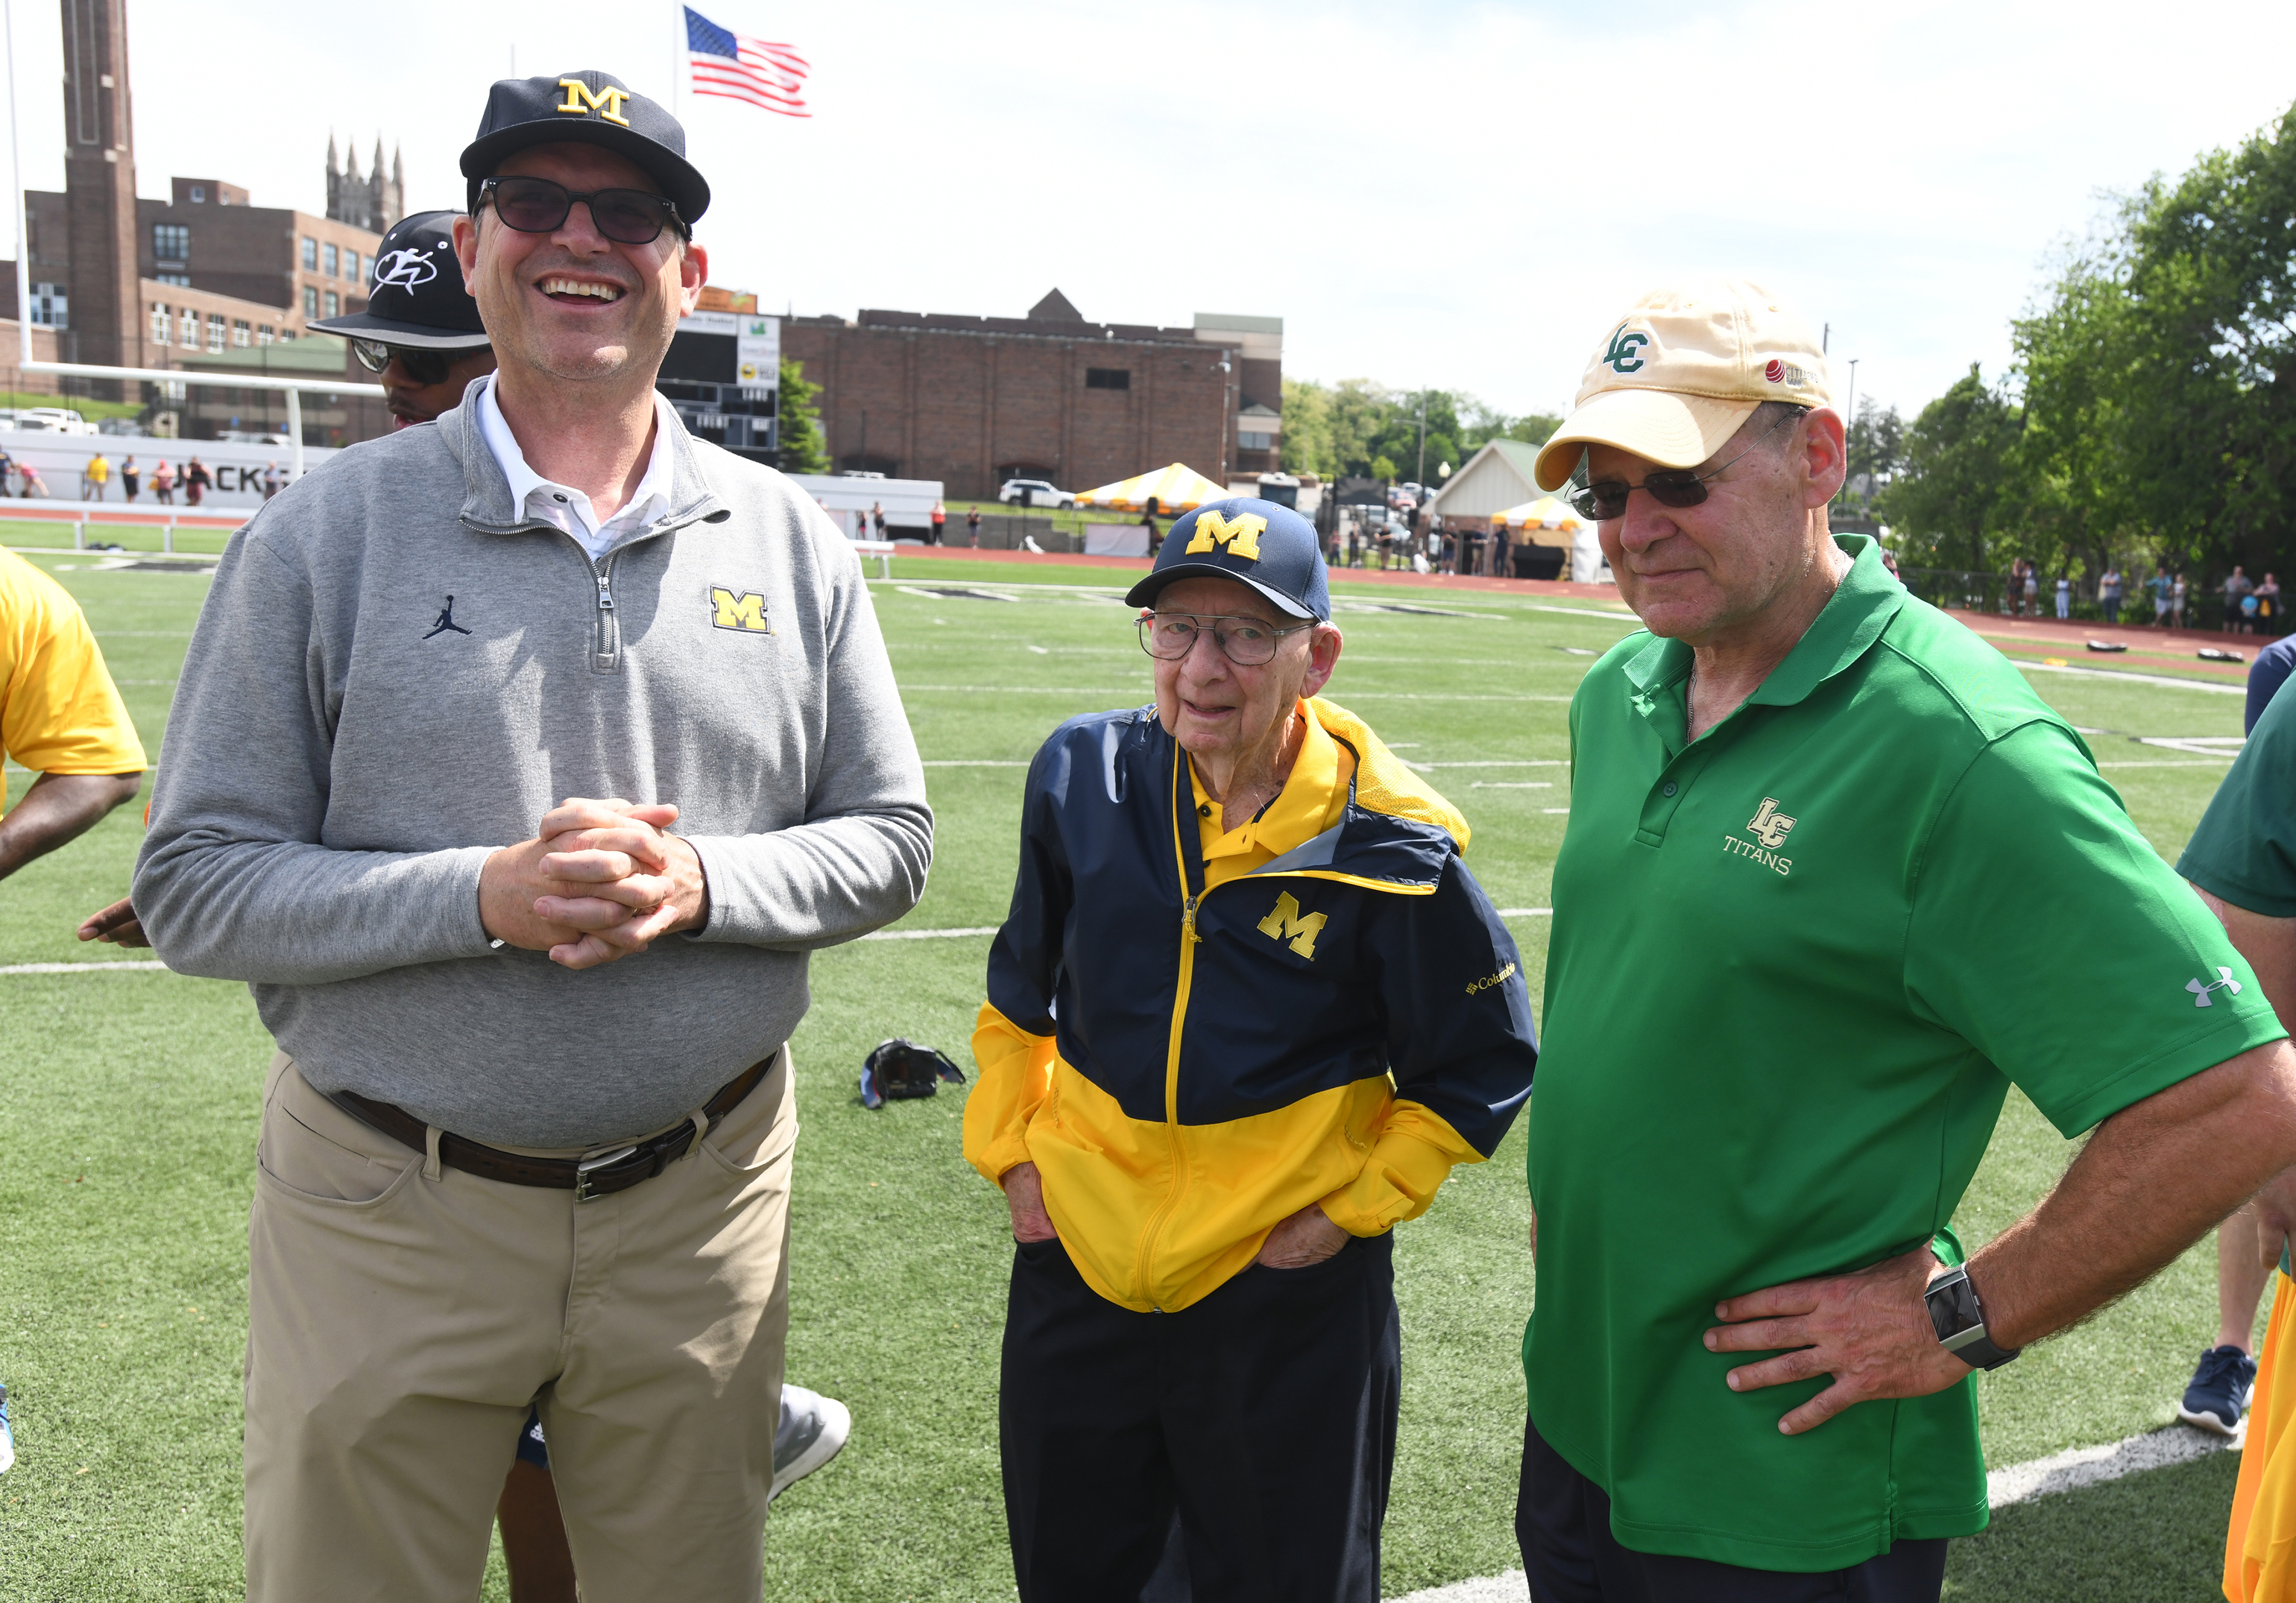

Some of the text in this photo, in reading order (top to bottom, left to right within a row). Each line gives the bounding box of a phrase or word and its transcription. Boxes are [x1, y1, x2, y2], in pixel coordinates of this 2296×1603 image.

[558, 78, 630, 127] M
[1786, 376, 1803, 386] BANK
[1185, 510, 1268, 560] M
[710, 584, 770, 634] M
[1746, 797, 1797, 850] LC
[1723, 835, 1793, 876] TITANS
[1257, 891, 1328, 959] M
[1478, 962, 1516, 990] Columbia
